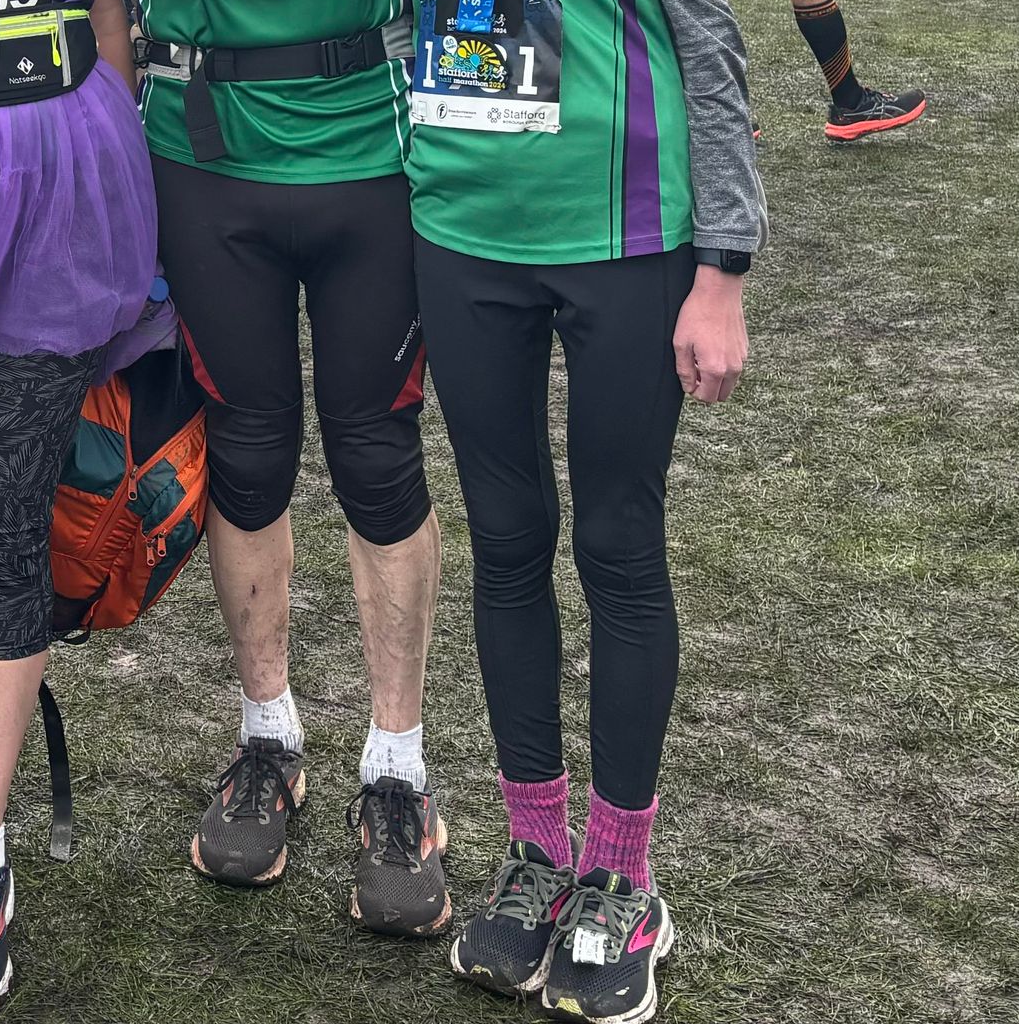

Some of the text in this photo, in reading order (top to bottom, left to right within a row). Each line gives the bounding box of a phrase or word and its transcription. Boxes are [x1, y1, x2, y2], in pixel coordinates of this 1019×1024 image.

[438, 67, 478, 79] stafford
[453, 79, 489, 88] marathon
[489, 81, 506, 89] 2024
[503, 108, 546, 120] Stafford
[394, 320, 418, 362] saucony
